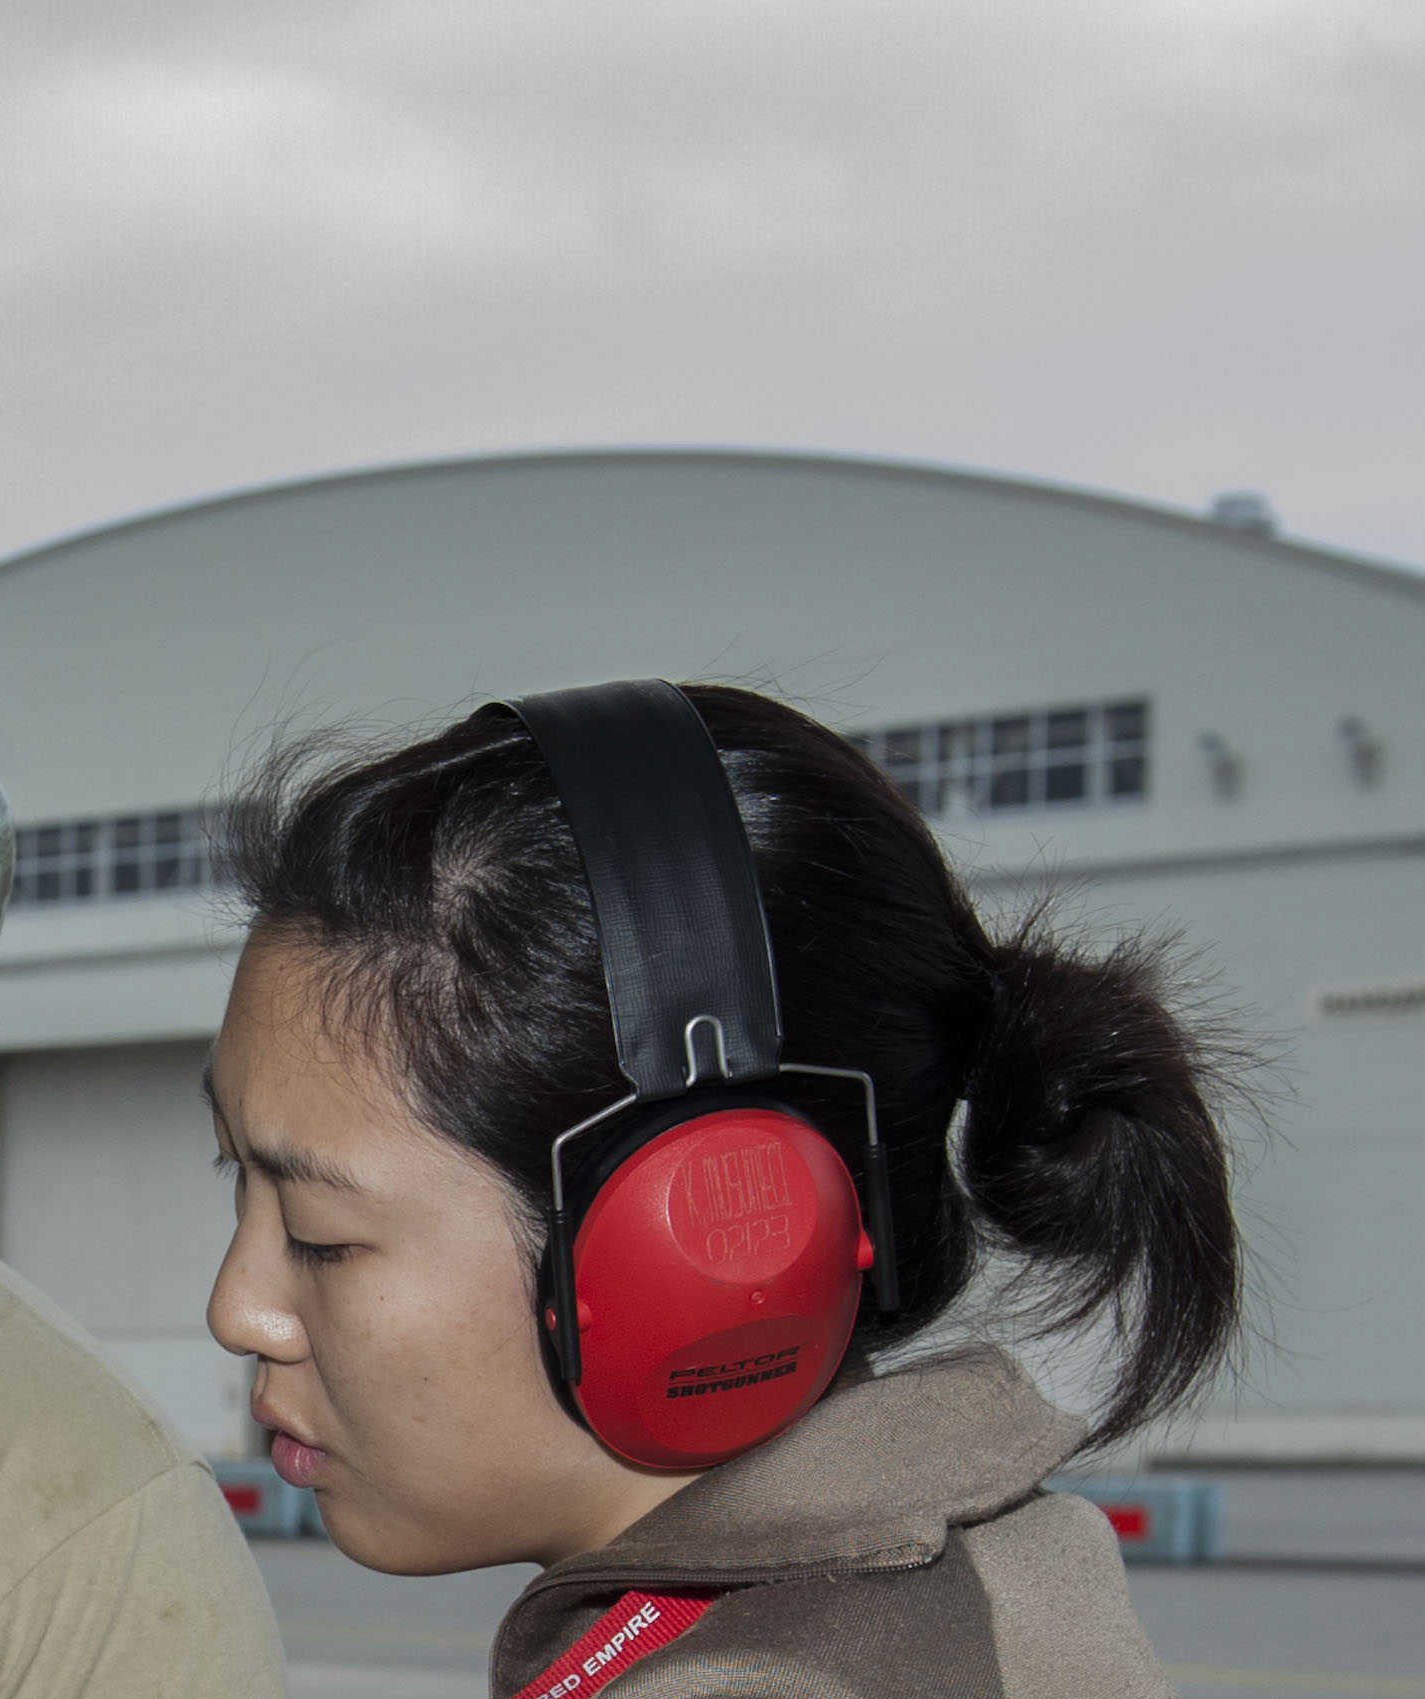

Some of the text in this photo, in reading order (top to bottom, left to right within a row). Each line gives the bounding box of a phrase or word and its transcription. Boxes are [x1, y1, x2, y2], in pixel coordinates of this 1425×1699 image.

[666, 1361, 798, 1399] SHOTGUNNER
[669, 1345, 801, 1381] PELTOR
[582, 1602, 661, 1677] EMPIRE
